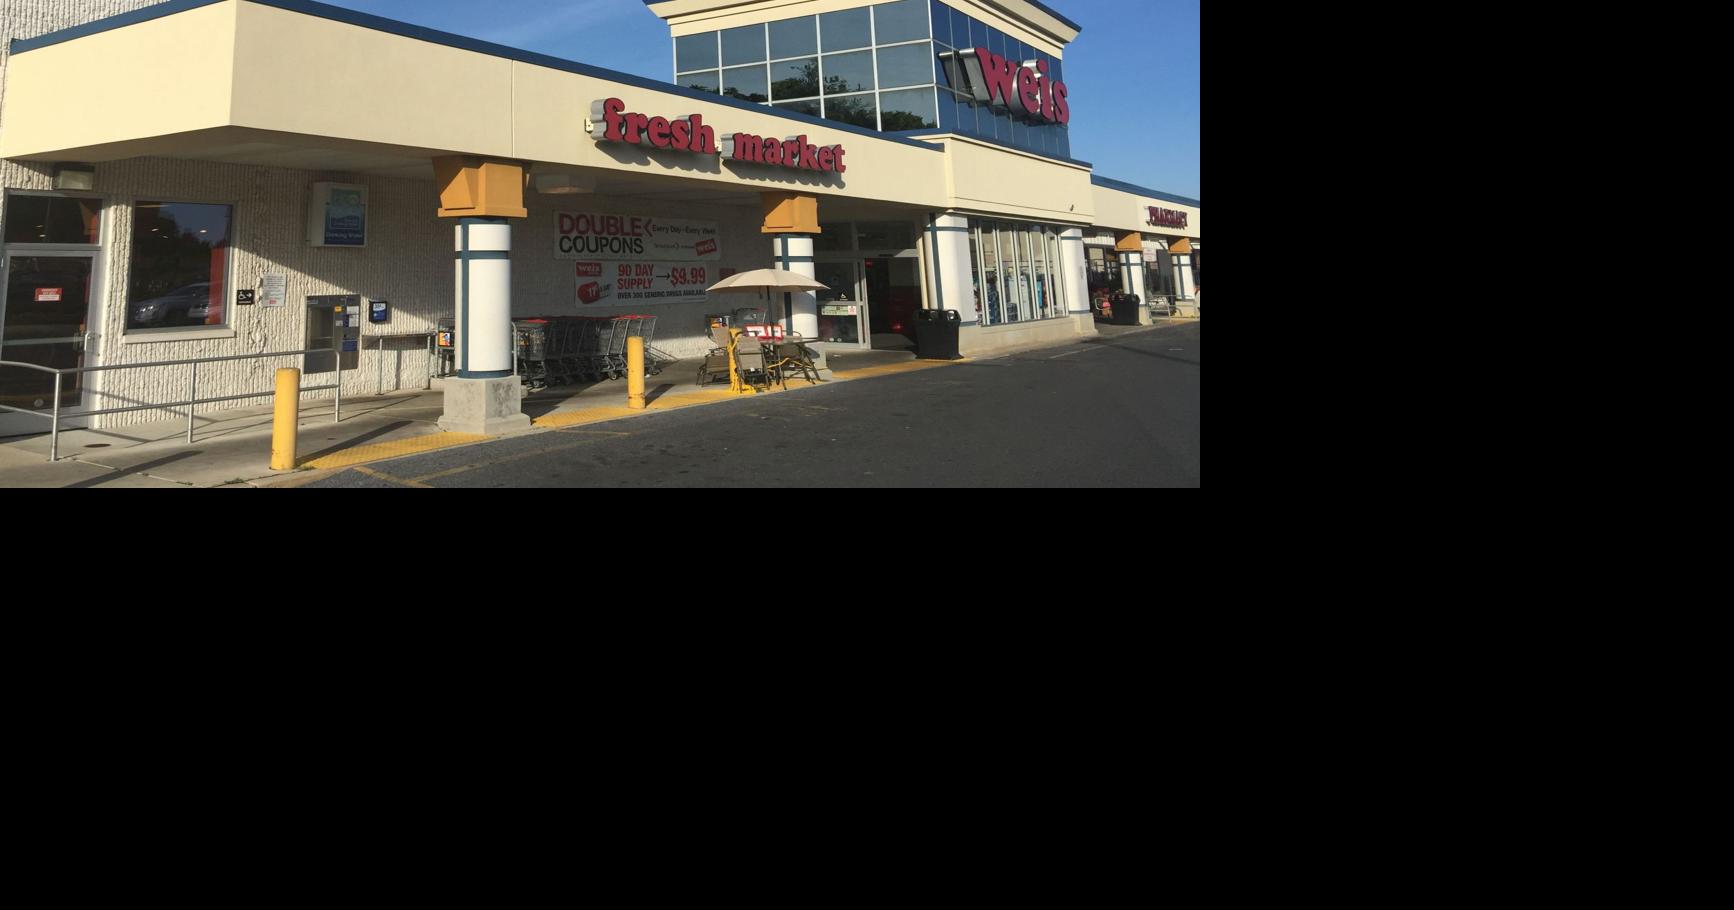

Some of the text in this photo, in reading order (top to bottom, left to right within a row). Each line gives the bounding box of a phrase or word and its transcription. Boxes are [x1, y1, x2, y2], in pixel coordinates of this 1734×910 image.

[602, 97, 847, 173] fresh market
[559, 213, 642, 237] DOUBLE
[652, 224, 669, 234] Every
[559, 236, 644, 254] COUPONS
[618, 264, 654, 277] 90 DAY
[670, 267, 706, 287] $9.99
[617, 278, 654, 290] SUPPLY
